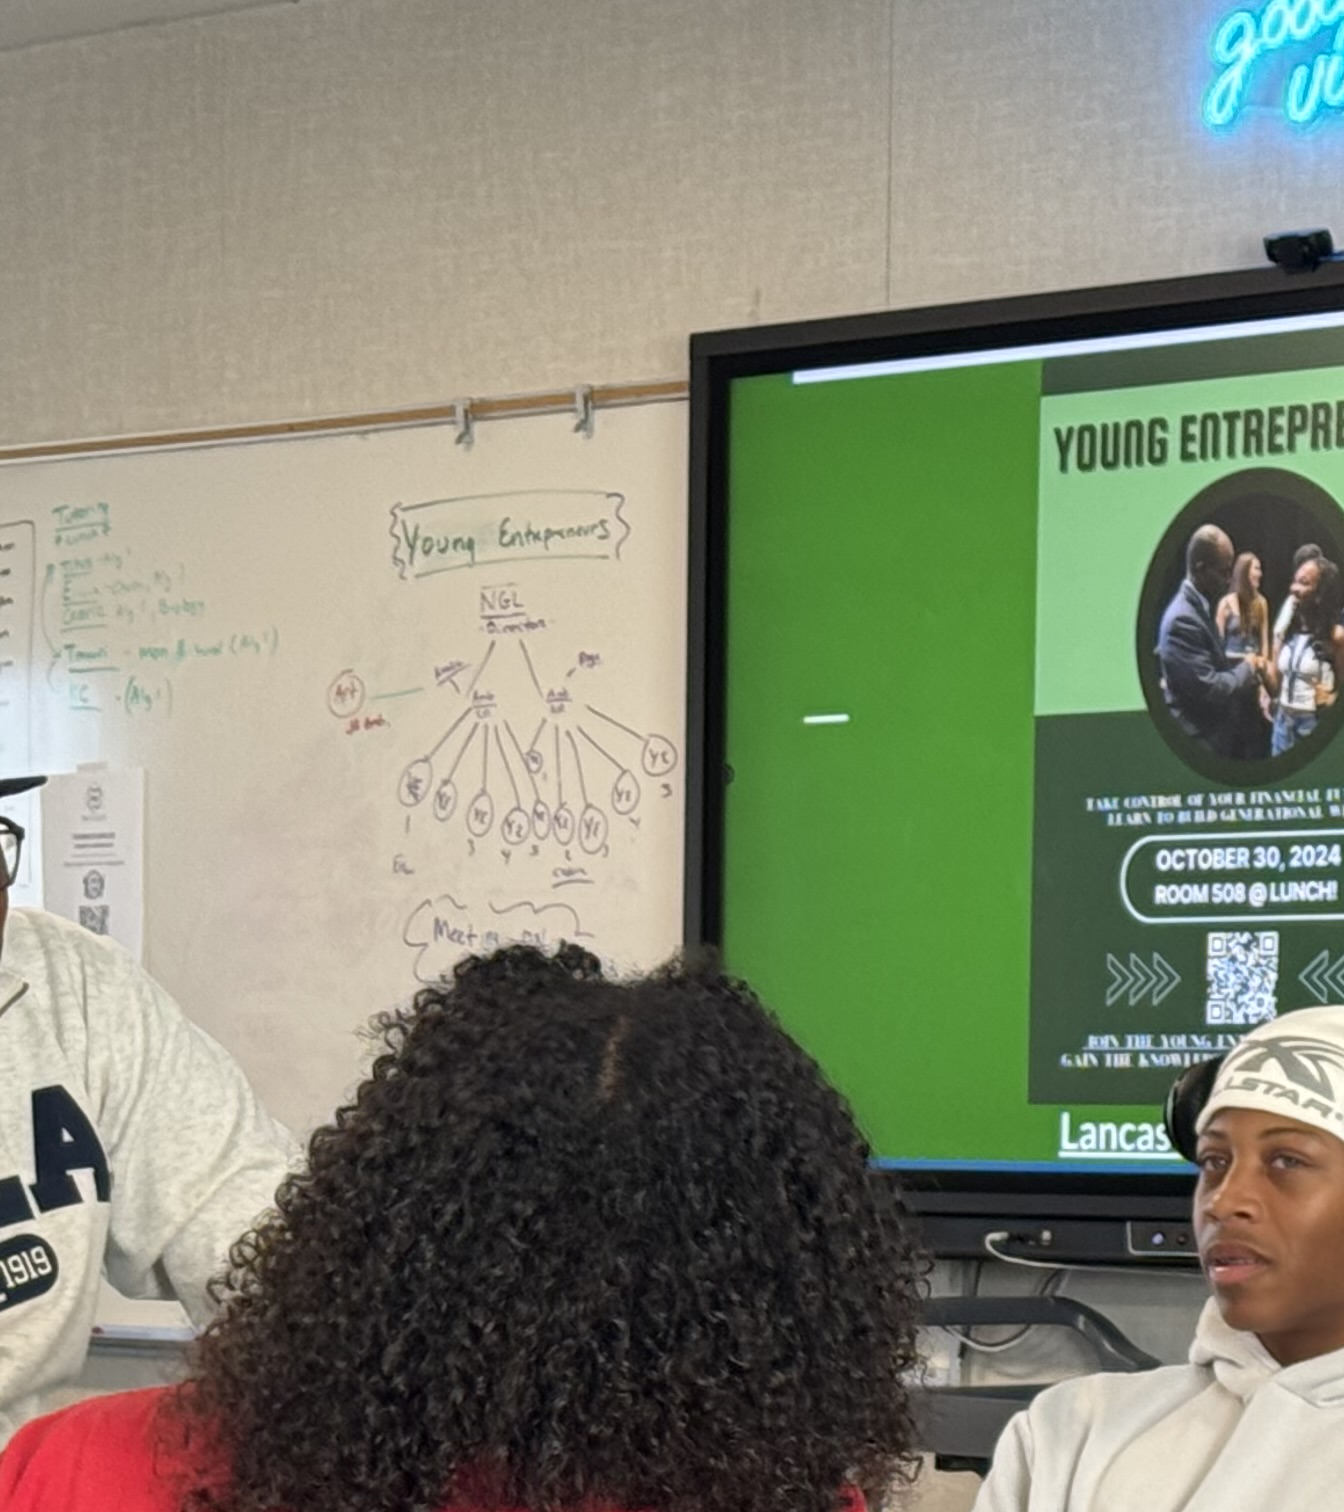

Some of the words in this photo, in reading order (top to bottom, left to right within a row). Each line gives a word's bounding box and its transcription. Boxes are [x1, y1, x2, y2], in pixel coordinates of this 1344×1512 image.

[1054, 416, 1169, 474] YOUNG
[400, 519, 476, 567] Young
[480, 590, 525, 612] NGL
[1086, 797, 1119, 811] TAKE
[1124, 794, 1182, 810] CONTROL
[1187, 793, 1205, 807] OF
[1209, 791, 1247, 806] YOUR
[1250, 788, 1322, 804] FINANCIAL
[1108, 811, 1152, 826] LEARN
[1157, 810, 1174, 824] TO
[1178, 808, 1218, 824] BUILD
[1220, 805, 1323, 822] GENERATIONAL
[1156, 848, 1250, 871] OCTOBER
[1253, 846, 1285, 873] 30,
[1289, 844, 1342, 868] 2024
[1154, 883, 1208, 905] ROOM
[1212, 882, 1246, 904] 508
[1249, 885, 1267, 907] @
[1270, 880, 1338, 903] LUNCH!
[1087, 1034, 1119, 1049] JOIN
[1126, 1034, 1154, 1048] THE
[1160, 1033, 1212, 1048] YOUNG
[1060, 1053, 1099, 1068] GAIN
[1106, 1053, 1134, 1068] THE
[1060, 1111, 1172, 1151] Lancas
